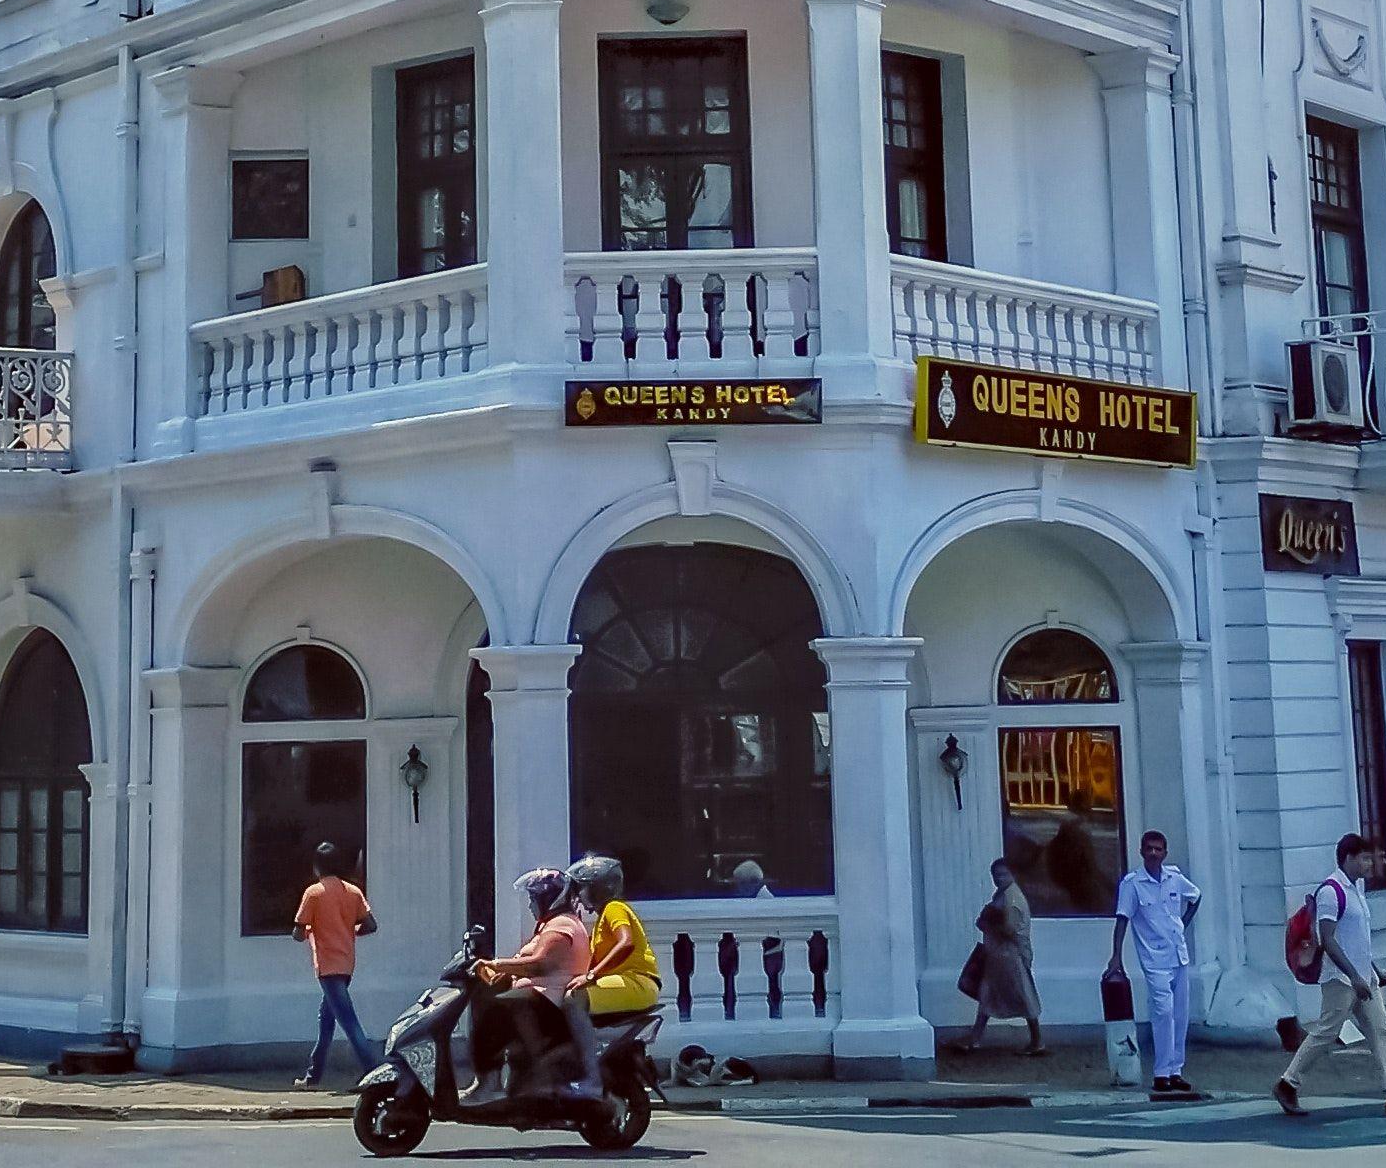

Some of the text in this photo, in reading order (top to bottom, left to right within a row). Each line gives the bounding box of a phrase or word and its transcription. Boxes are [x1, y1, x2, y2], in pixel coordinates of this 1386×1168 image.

[715, 385, 796, 405] HOTEL
[656, 407, 731, 420] KANDY
[1099, 391, 1180, 435] HOTEL
[1039, 427, 1097, 451] KANDY
[1278, 508, 1348, 565] Queen's
